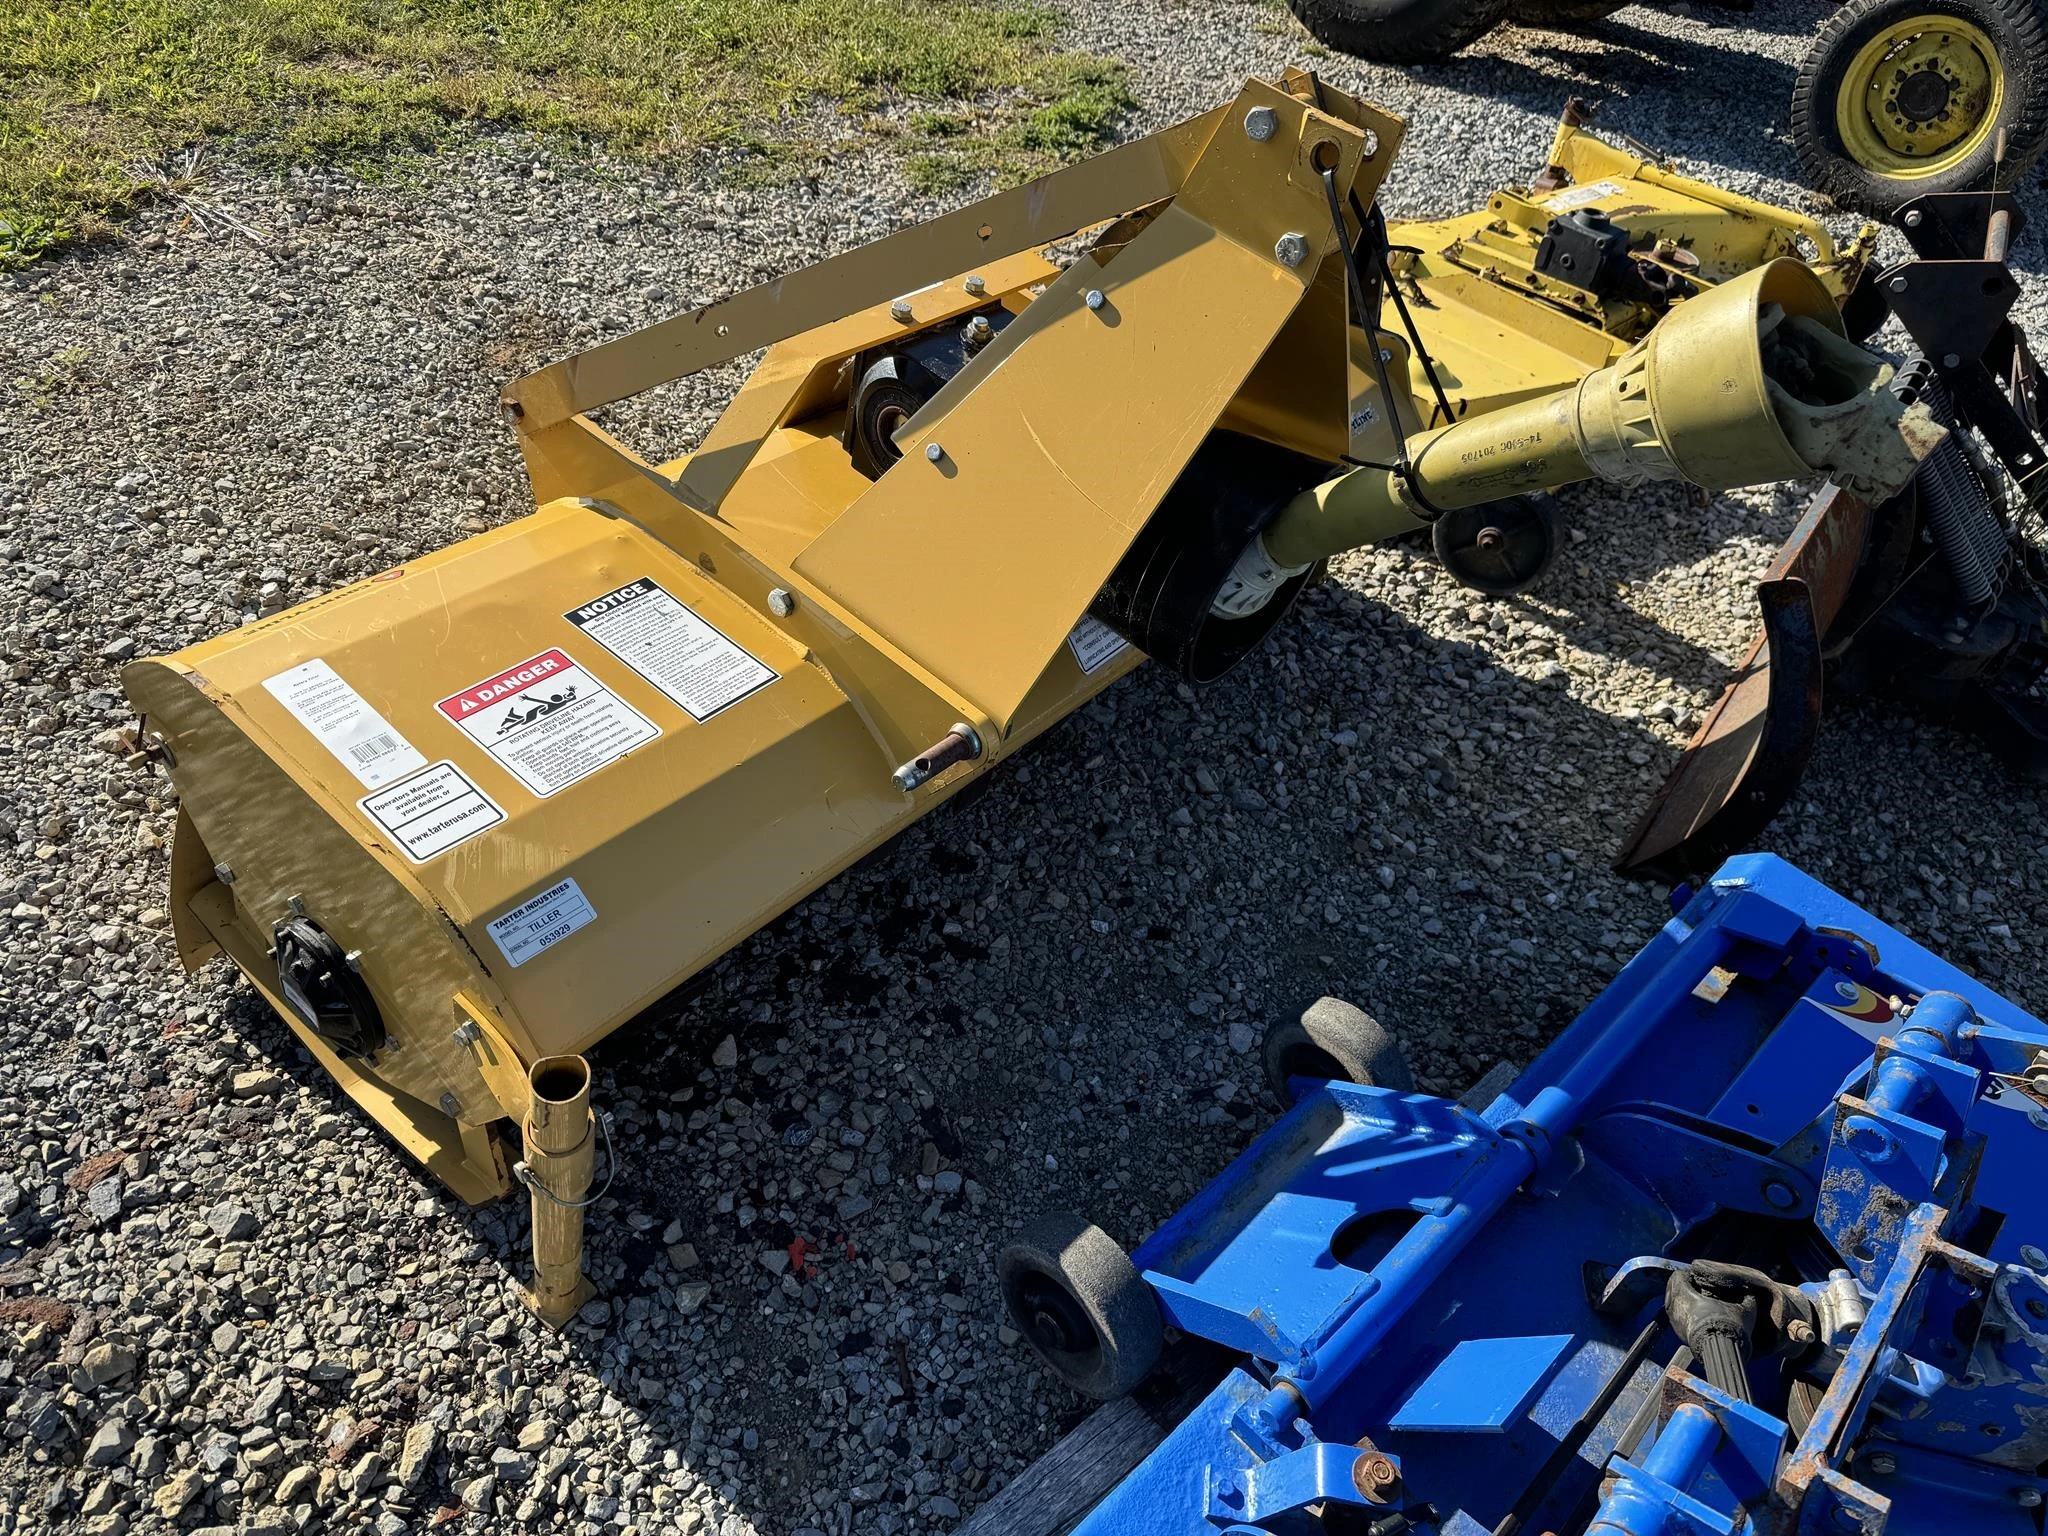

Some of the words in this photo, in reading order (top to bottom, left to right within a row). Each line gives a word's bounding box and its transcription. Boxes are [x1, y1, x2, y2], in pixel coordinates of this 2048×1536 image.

[575, 582, 648, 619] NOTICE
[475, 658, 561, 701] DANGER
[507, 726, 541, 744] ROTATING
[538, 710, 572, 728] DRIVELINE
[570, 698, 596, 712] HAZARD
[539, 723, 559, 734] KEEP
[556, 715, 576, 725] AWAY
[520, 753, 536, 762] Keep
[540, 741, 559, 752] guards
[524, 752, 547, 766] Operate
[528, 760, 544, 769] Keep
[373, 791, 411, 811] Operators
[408, 777, 440, 794] Manuals
[438, 771, 452, 779] are
[393, 791, 427, 810] available
[425, 783, 444, 794] from
[400, 805, 418, 817] your
[416, 793, 442, 808] dealer,
[405, 801, 487, 846] www.tarterusa.com
[493, 908, 524, 930] TARTER
[524, 882, 569, 912] INDUSTRIES
[527, 908, 561, 933] TILLER
[538, 922, 571, 947] 053929
